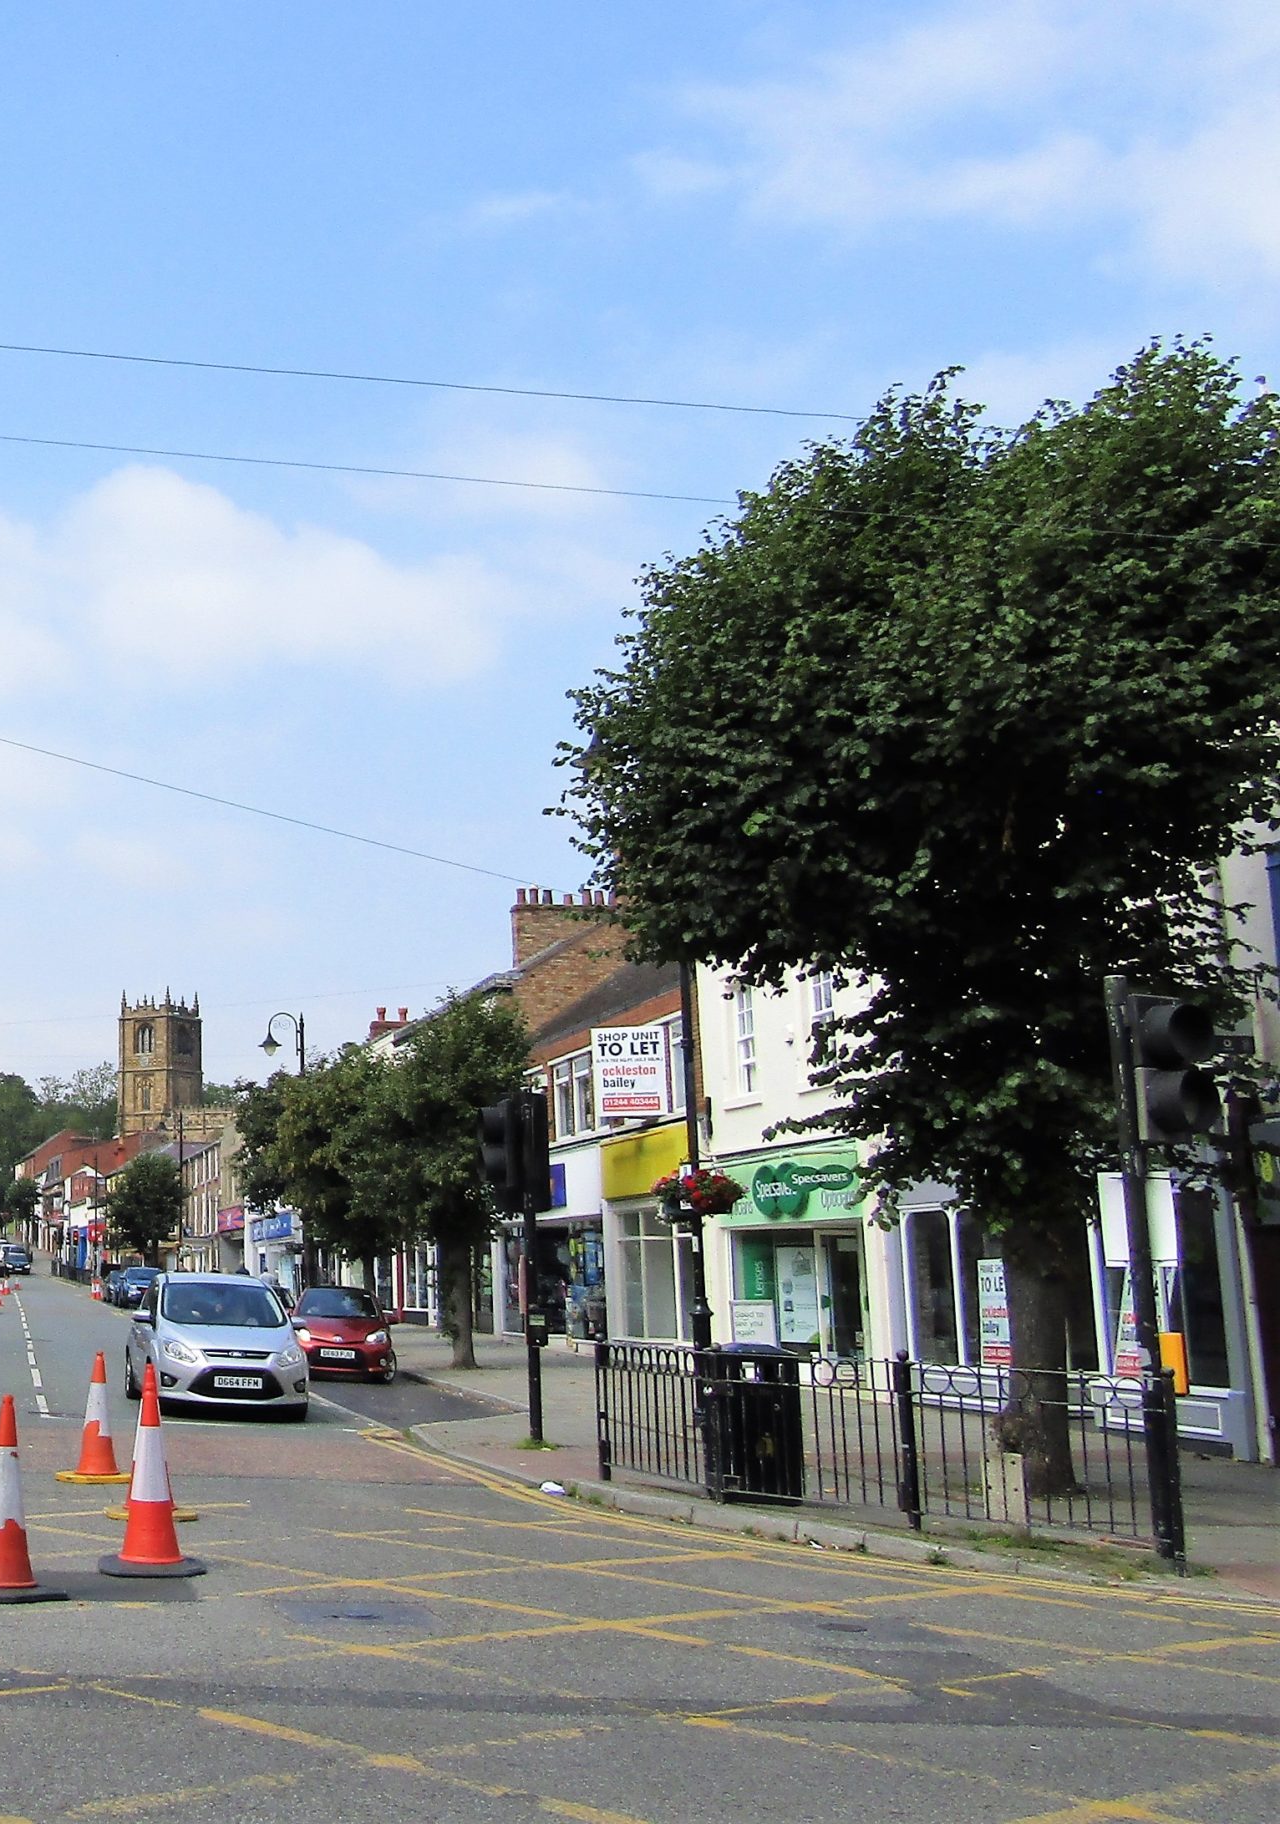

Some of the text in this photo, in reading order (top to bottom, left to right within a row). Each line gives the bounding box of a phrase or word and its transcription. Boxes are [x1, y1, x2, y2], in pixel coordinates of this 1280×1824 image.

[597, 1031, 660, 1042] SHOP UNIT
[598, 1041, 660, 1057] TO LET
[602, 1064, 657, 1077] ockleston
[603, 1077, 636, 1089] bailey
[604, 1097, 659, 1106] 01244 403444
[791, 1172, 848, 1185] Specsavers
[980, 1276, 1004, 1292] TO LE
